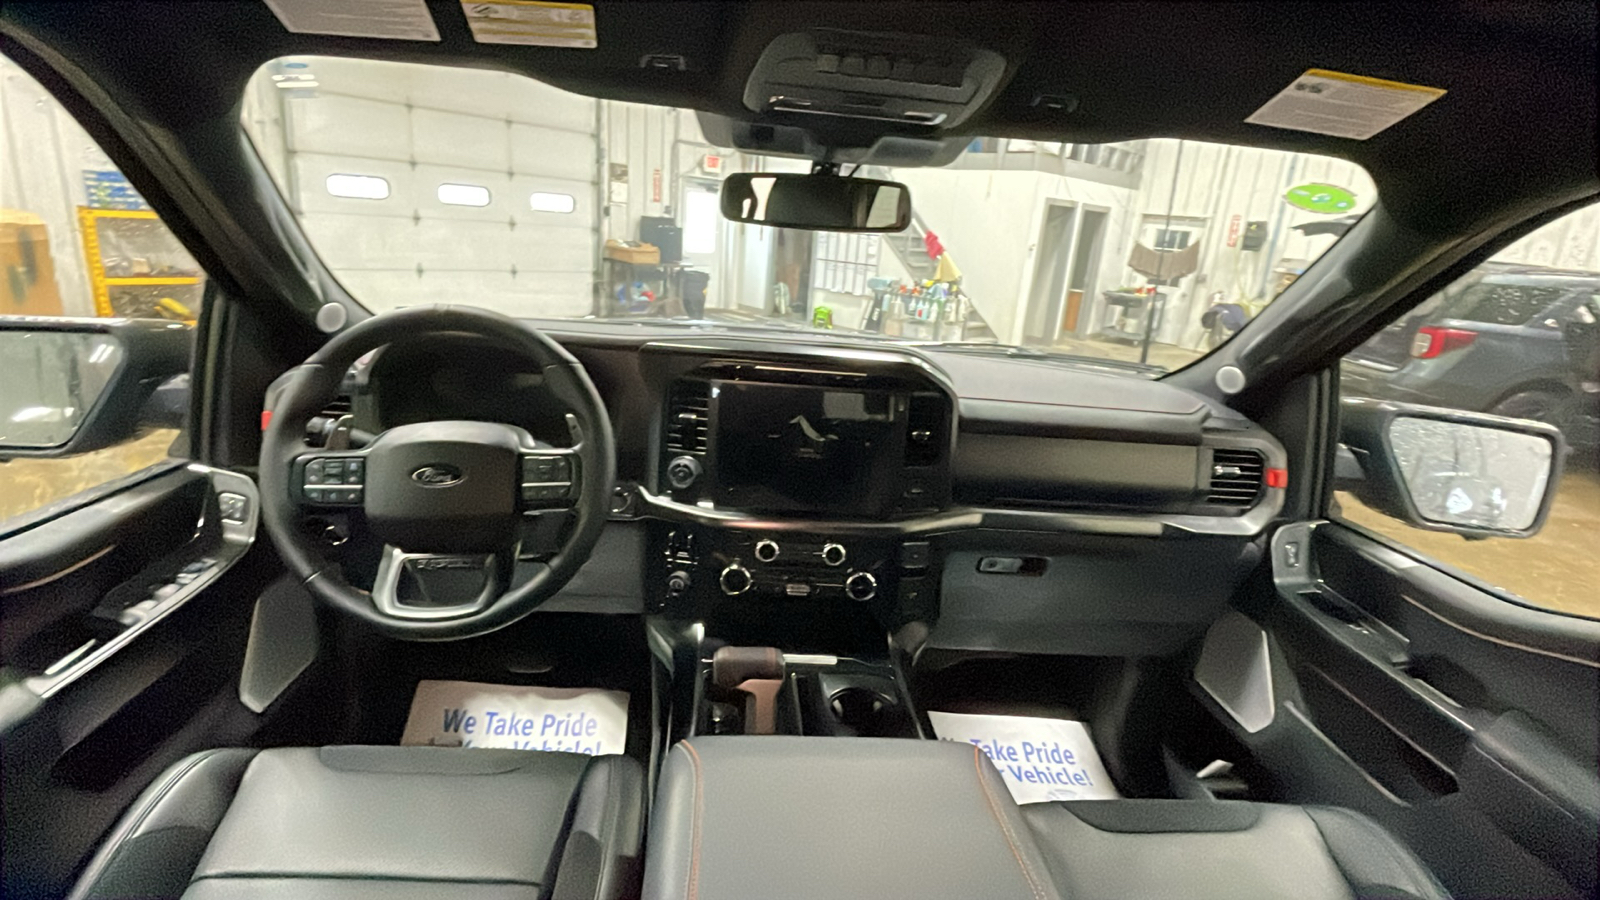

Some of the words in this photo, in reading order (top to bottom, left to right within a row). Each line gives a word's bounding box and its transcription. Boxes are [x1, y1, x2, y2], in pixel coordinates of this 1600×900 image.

[443, 708, 477, 734] We
[485, 711, 534, 736] Take
[540, 712, 598, 737] Pride
[1022, 741, 1077, 765] Pride
[1007, 765, 1094, 787] Vehicle!
